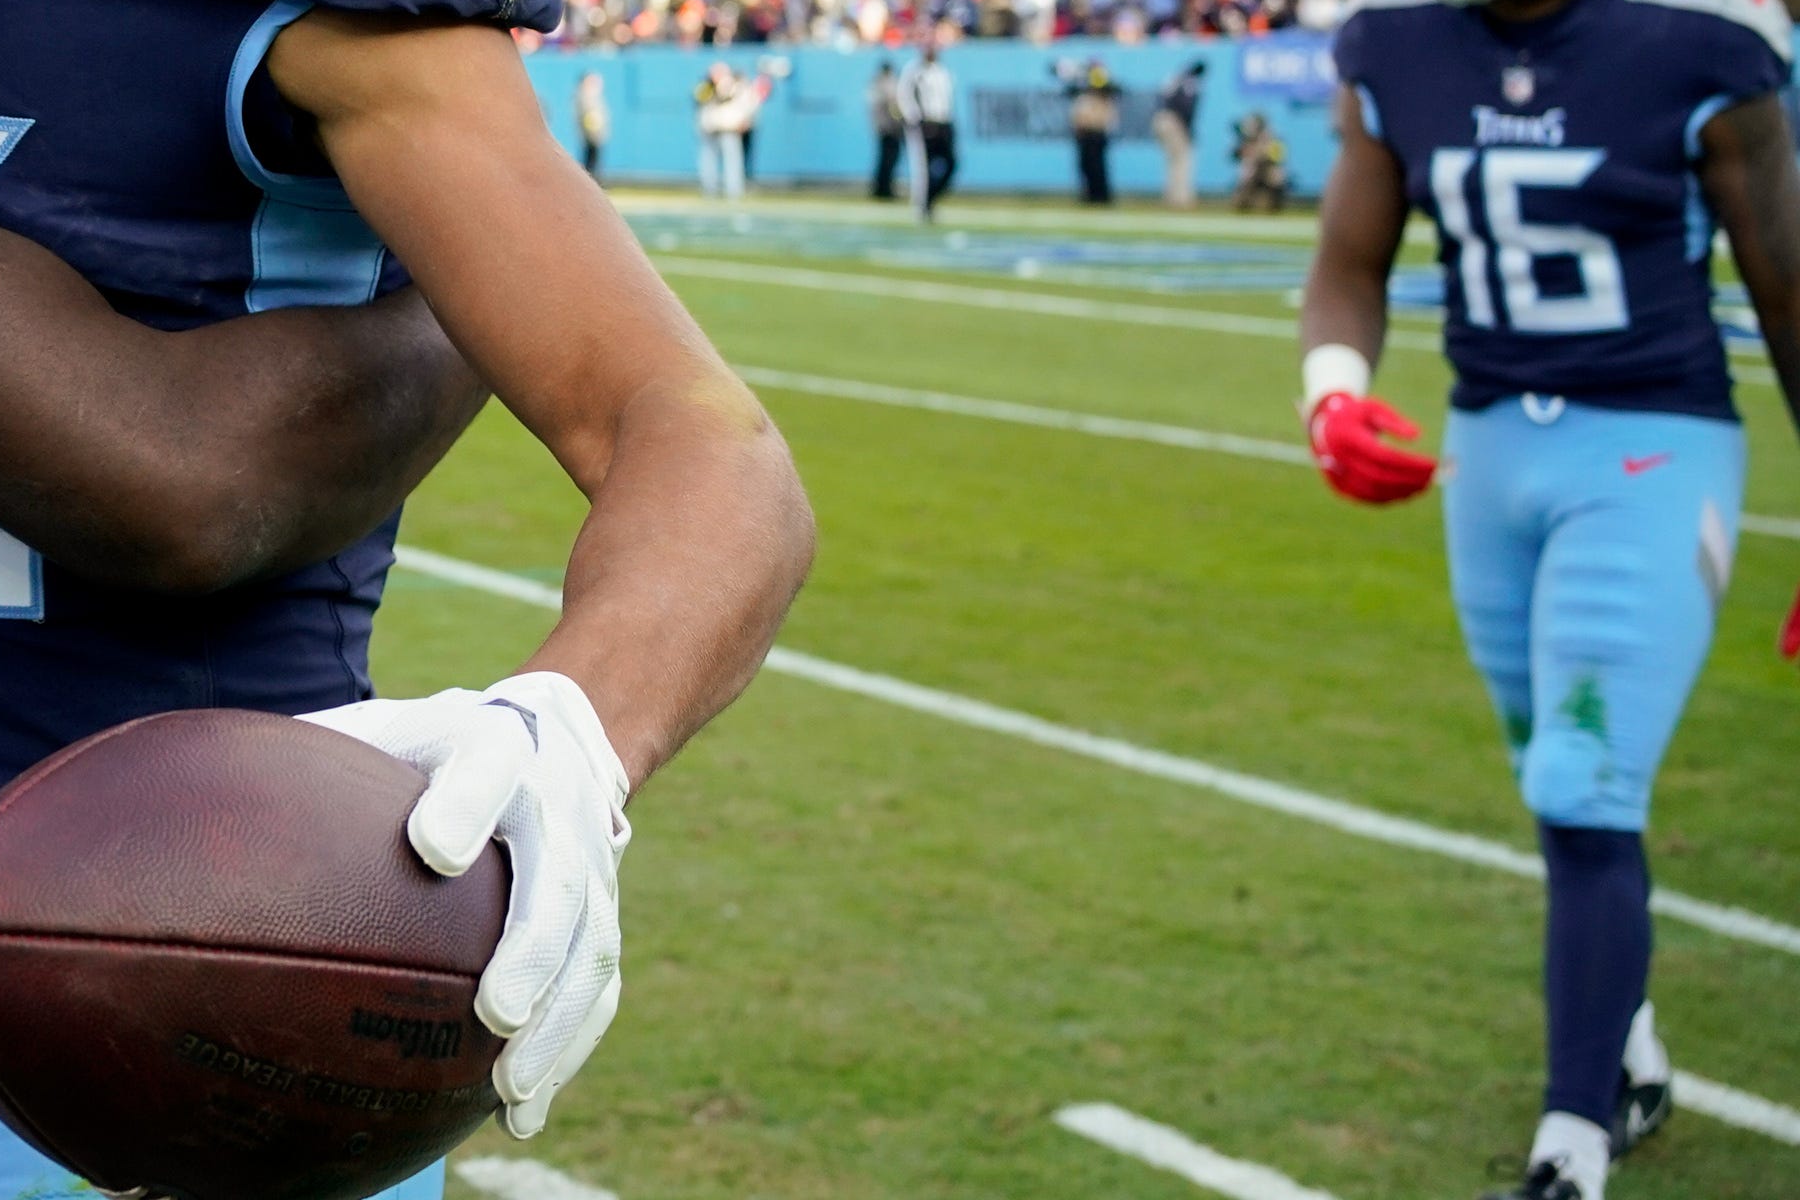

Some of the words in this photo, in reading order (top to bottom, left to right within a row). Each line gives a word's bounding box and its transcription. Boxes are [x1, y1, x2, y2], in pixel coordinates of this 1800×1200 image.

[1430, 146, 1631, 333] 16
[174, 1031, 293, 1092] LEAGUE
[304, 1076, 432, 1112] FOOTBALL
